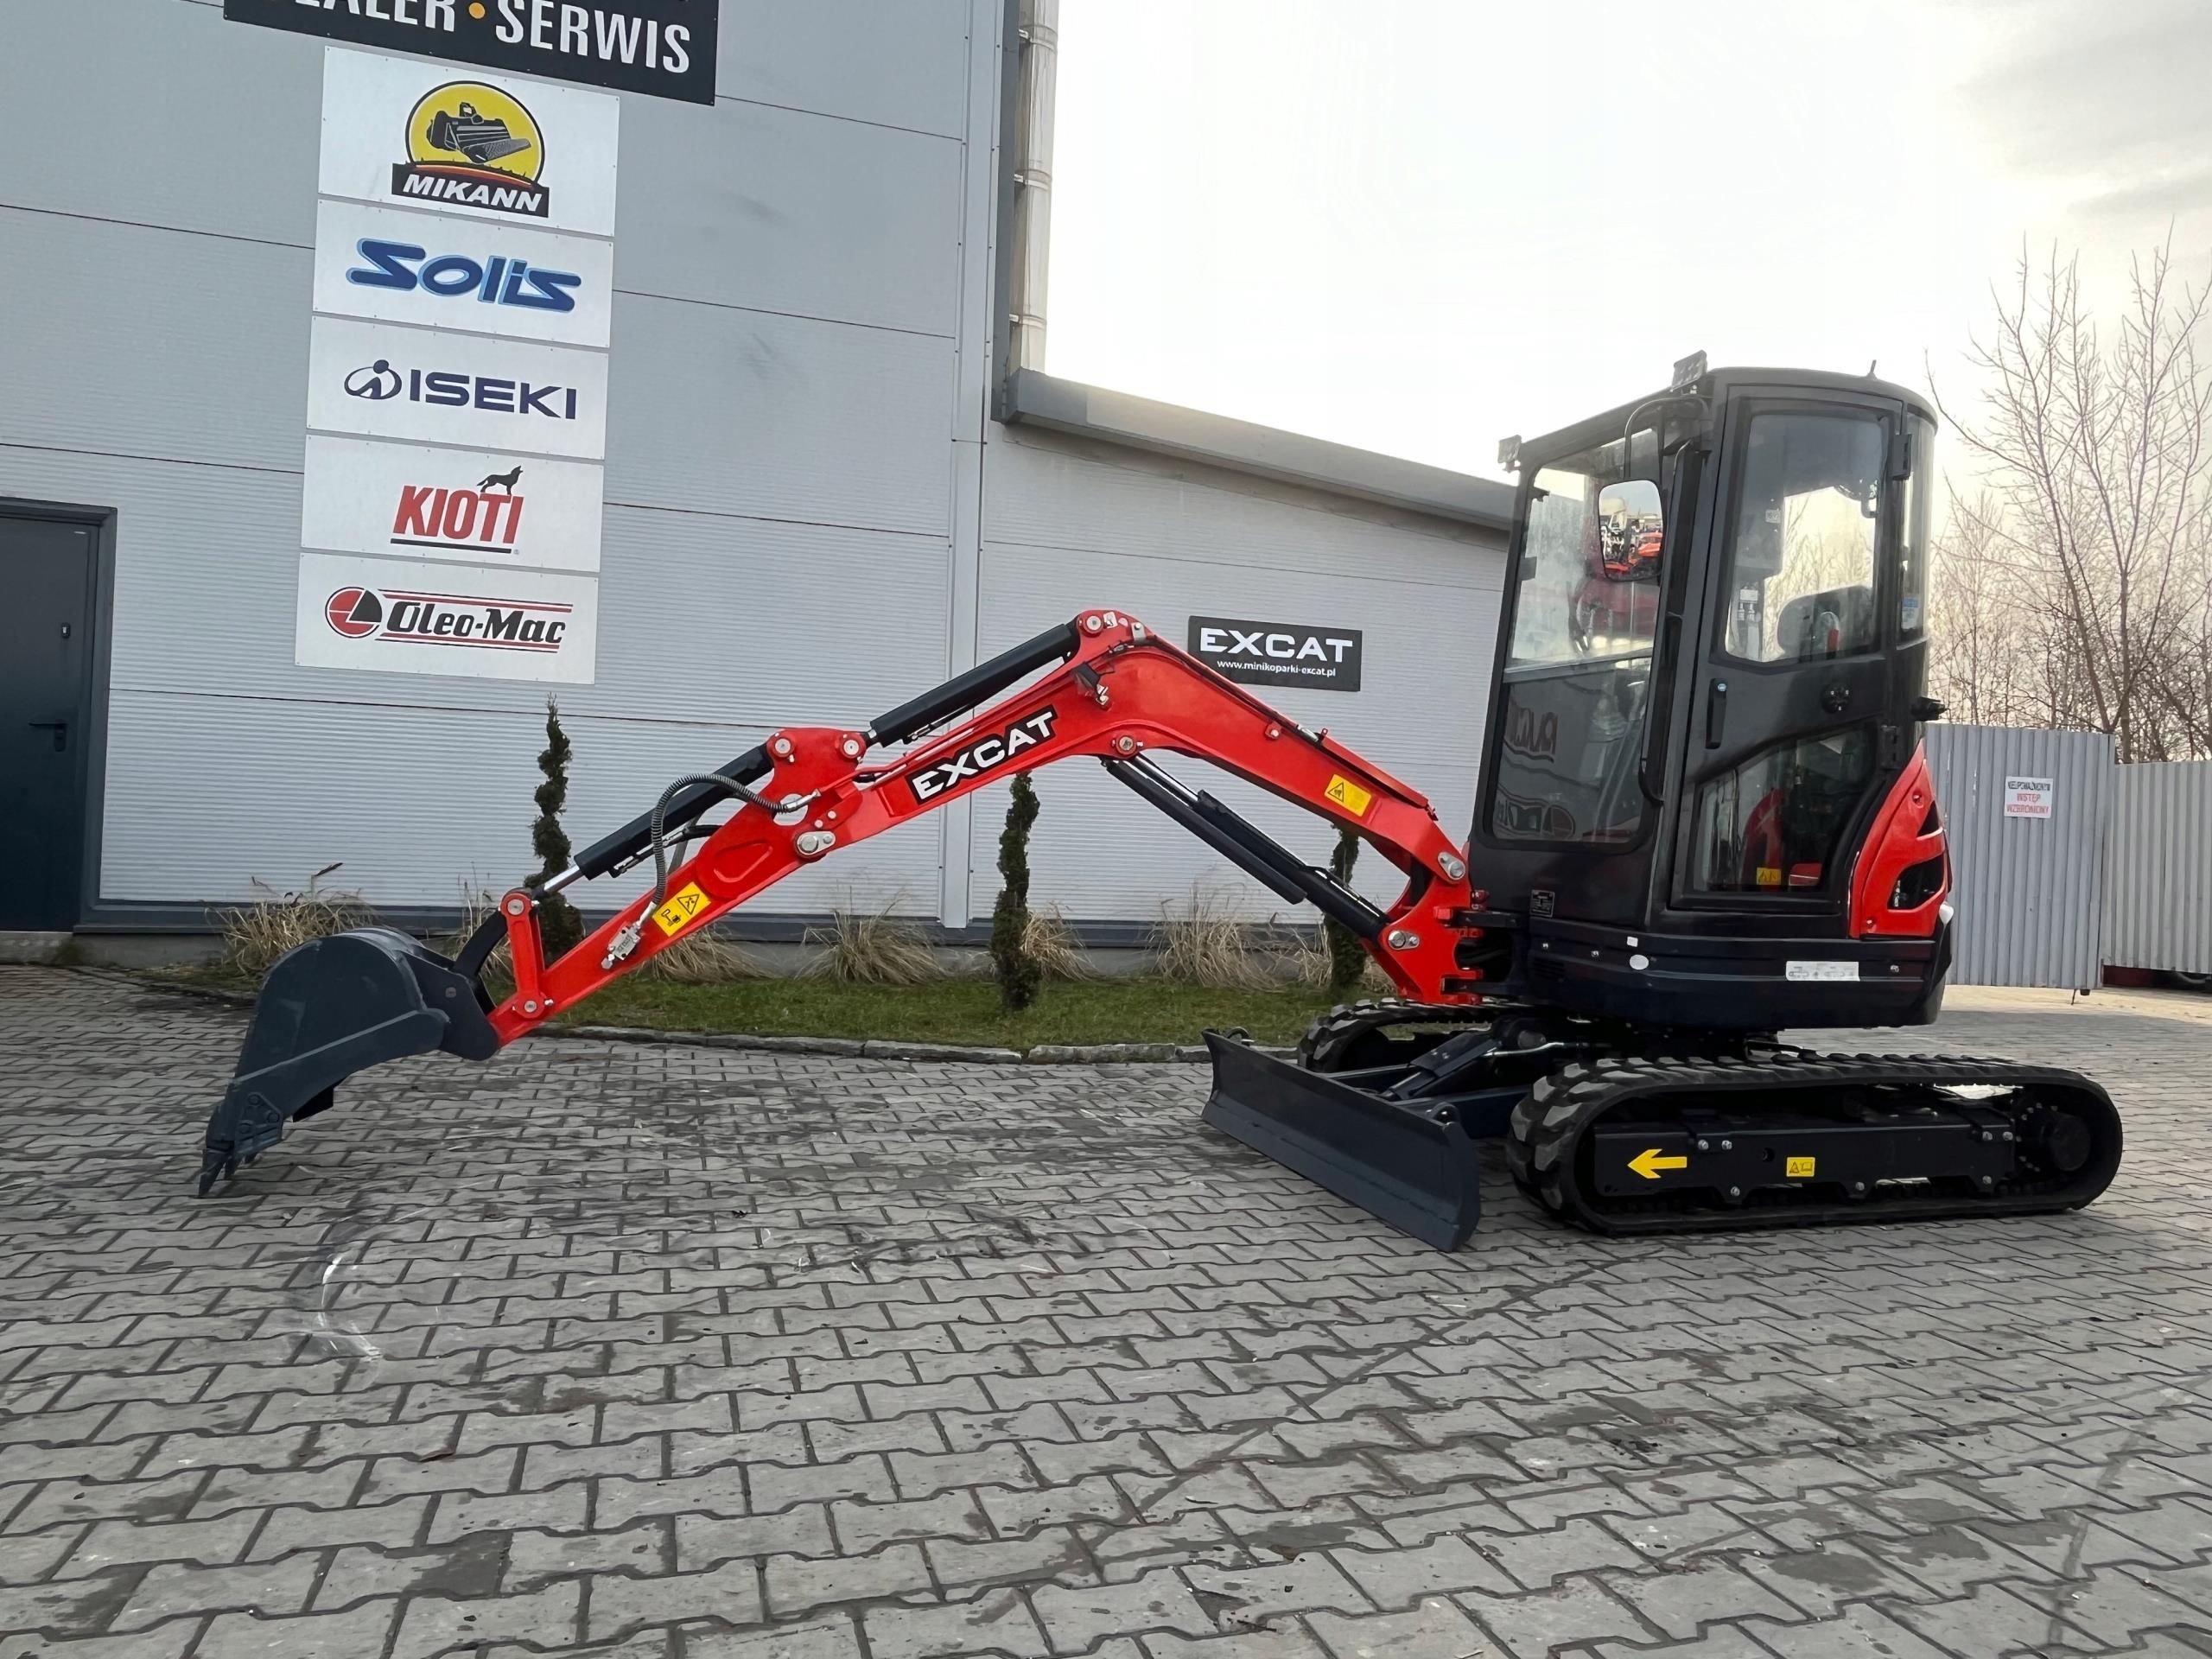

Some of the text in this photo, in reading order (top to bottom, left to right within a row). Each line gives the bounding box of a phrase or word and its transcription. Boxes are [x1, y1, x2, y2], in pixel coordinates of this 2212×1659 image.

[495, 0, 691, 74] SERWIS
[402, 173, 543, 212] MIKANN
[410, 368, 577, 420] ISEKI
[392, 484, 524, 544] KIOTI
[385, 601, 567, 645] Oleo-Mac
[1199, 627, 1353, 664] EXCAT
[1217, 659, 1337, 677] www.minikoparki-excat.pl
[912, 711, 1053, 800] EXCAT
